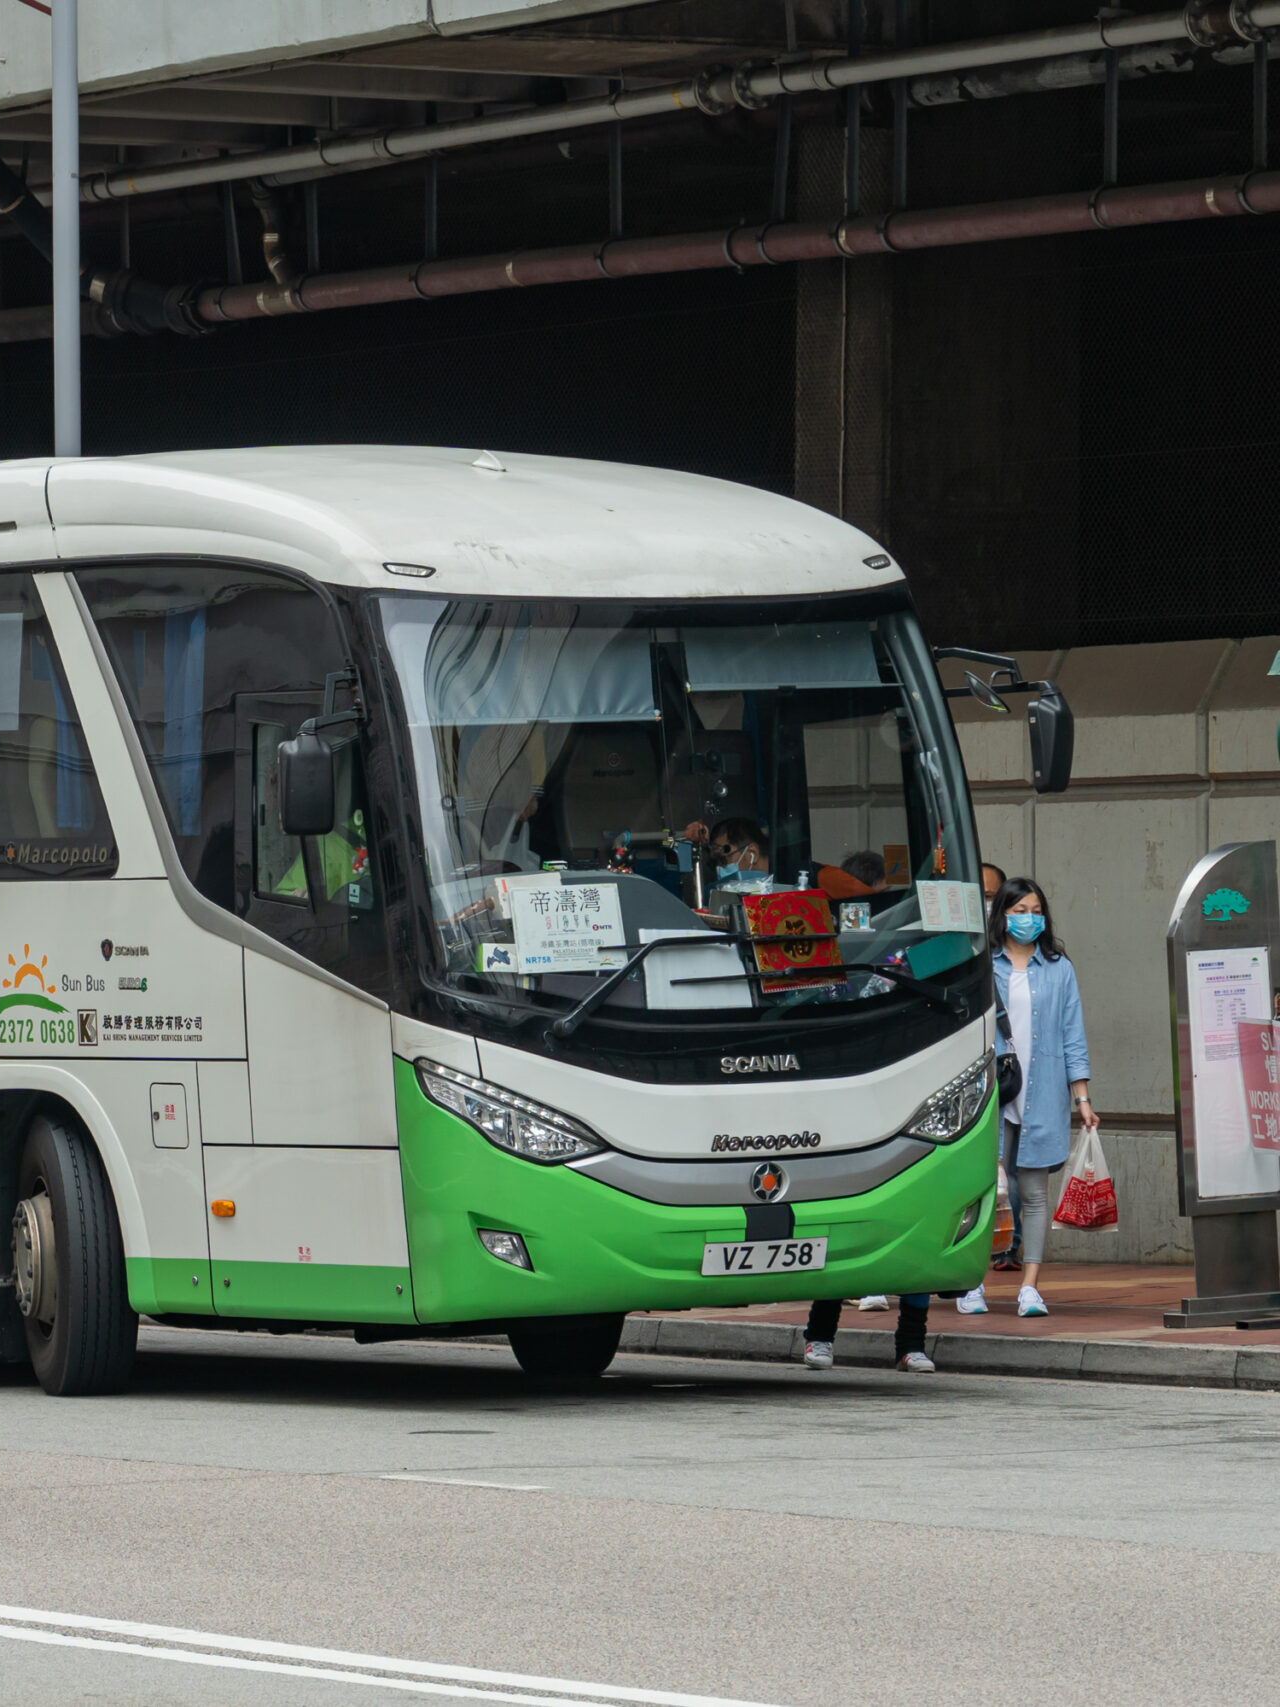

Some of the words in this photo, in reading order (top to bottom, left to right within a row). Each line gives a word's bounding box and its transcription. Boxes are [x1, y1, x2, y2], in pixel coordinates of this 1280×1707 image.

[18, 843, 107, 866] Marcopolo
[529, 887, 601, 915] 帝濤灣
[114, 945, 149, 957] SCANIA
[525, 956, 552, 965] NR758
[61, 974, 82, 992] Sun
[86, 974, 105, 992] Bus
[0, 1019, 34, 1044] 2372
[40, 1019, 75, 1044] 0638
[161, 1034, 183, 1042] SERVICES
[720, 1054, 801, 1075] SCANIA
[711, 1131, 821, 1152] Marcopolo
[723, 1247, 754, 1270] VZ
[767, 1243, 813, 1267] 758
